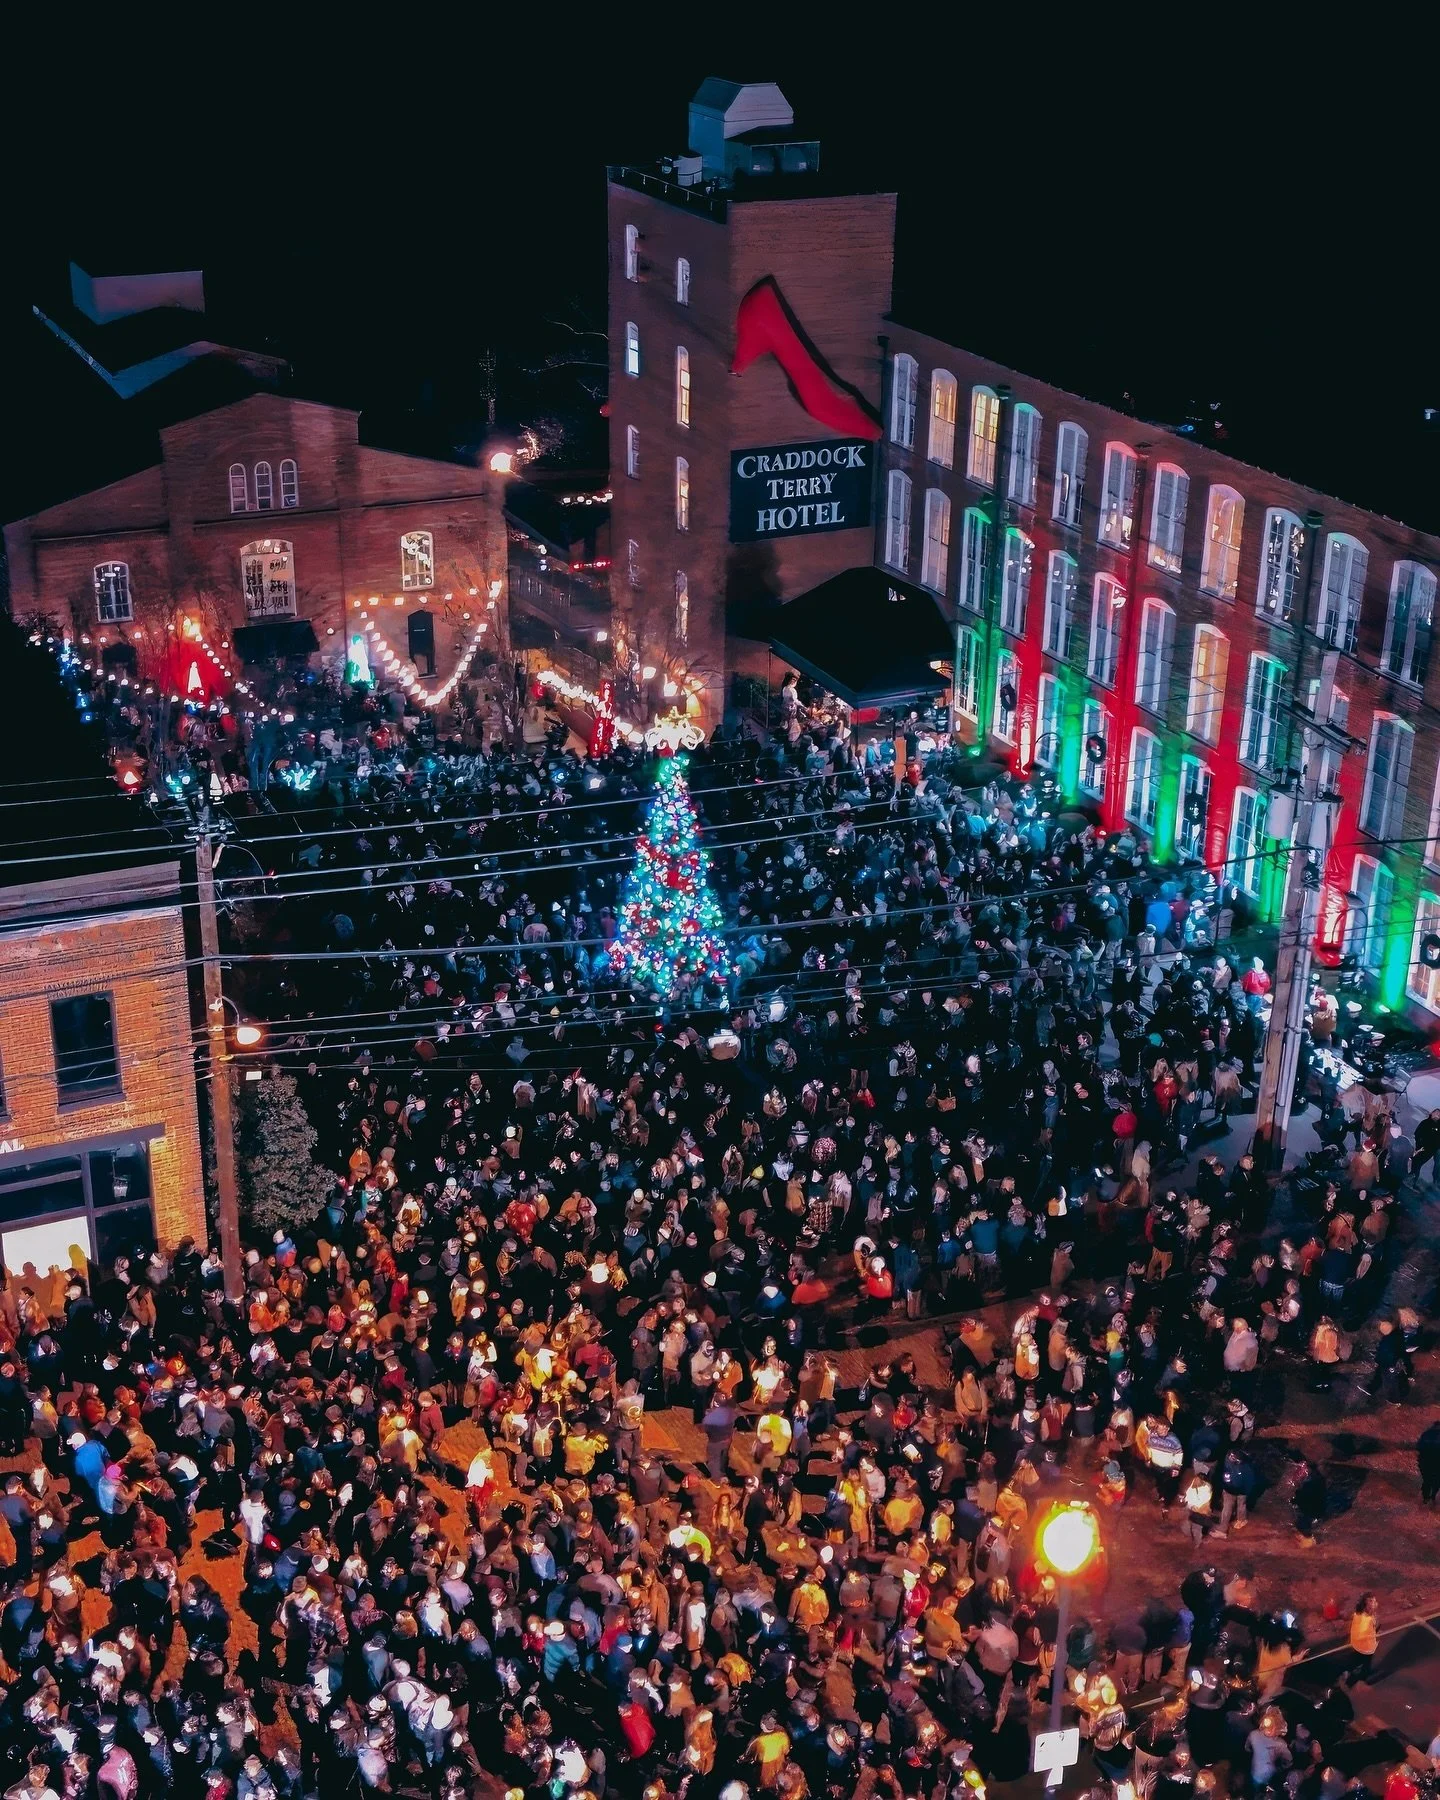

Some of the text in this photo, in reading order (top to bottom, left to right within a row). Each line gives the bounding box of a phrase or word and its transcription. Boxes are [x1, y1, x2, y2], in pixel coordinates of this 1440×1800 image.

[737, 445, 866, 478] CRADDOCK
[766, 473, 837, 500] TERRY
[756, 501, 845, 532] HOTEL
